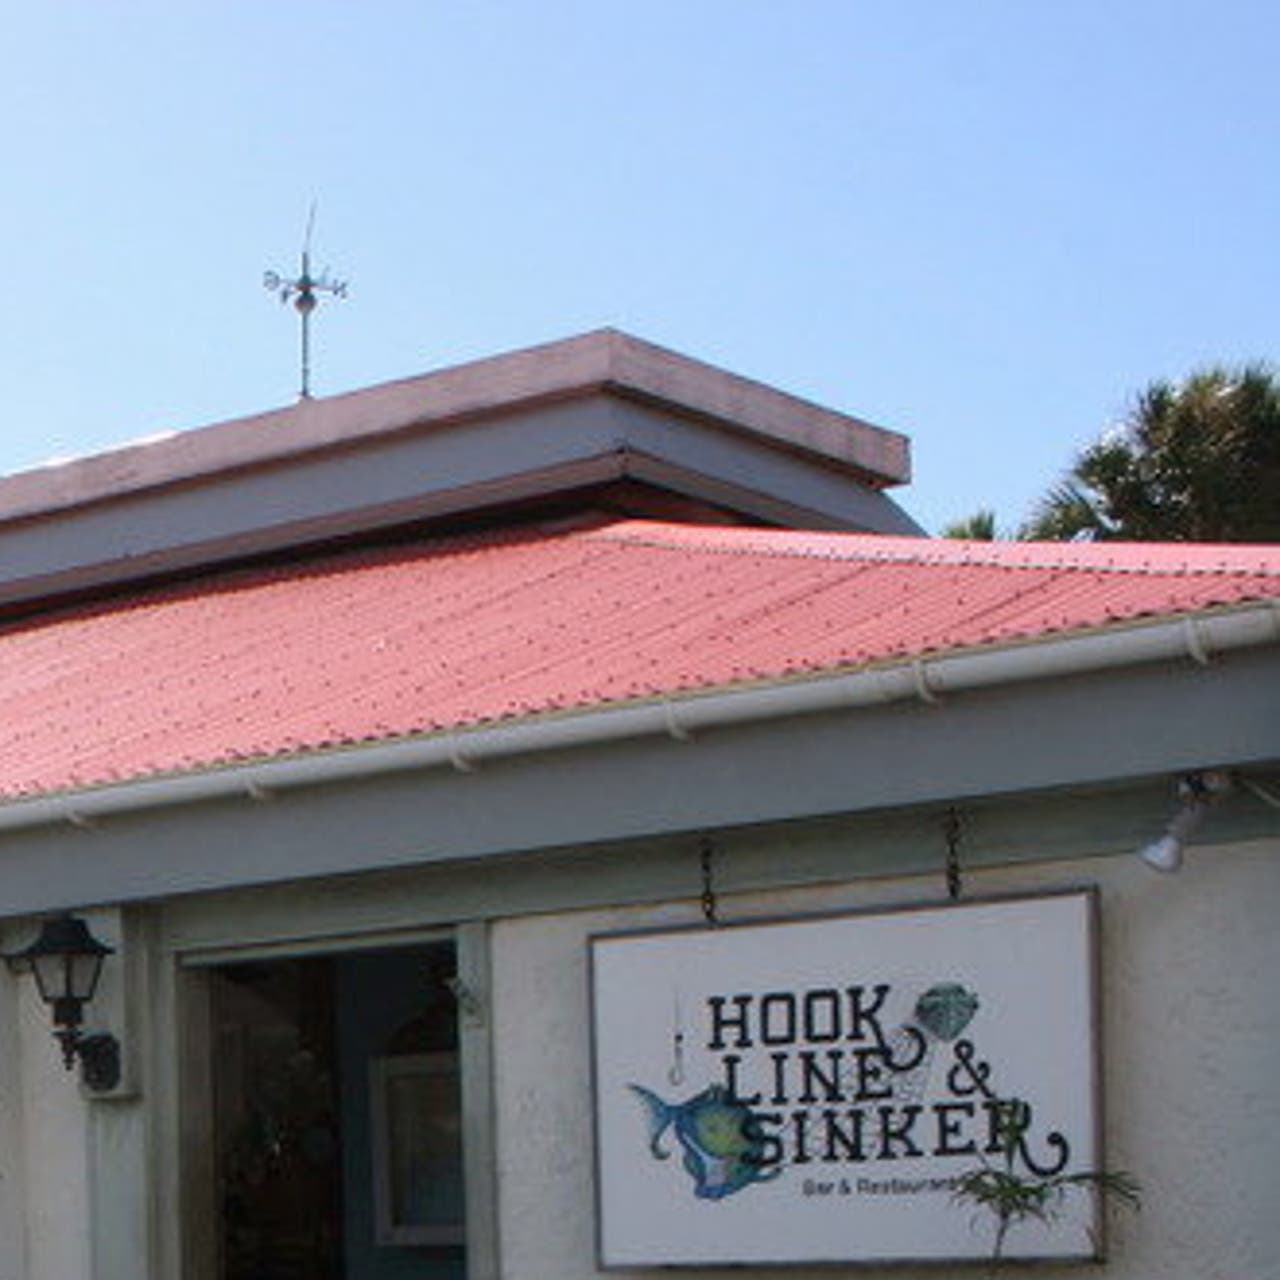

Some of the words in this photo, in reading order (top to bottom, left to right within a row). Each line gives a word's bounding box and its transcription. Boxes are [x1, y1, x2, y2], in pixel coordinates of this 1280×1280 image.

[708, 985, 927, 1072] HOOK
[719, 1050, 893, 1106] LINE
[948, 1039, 998, 1099] &
[741, 1098, 1069, 1176] SINKER
